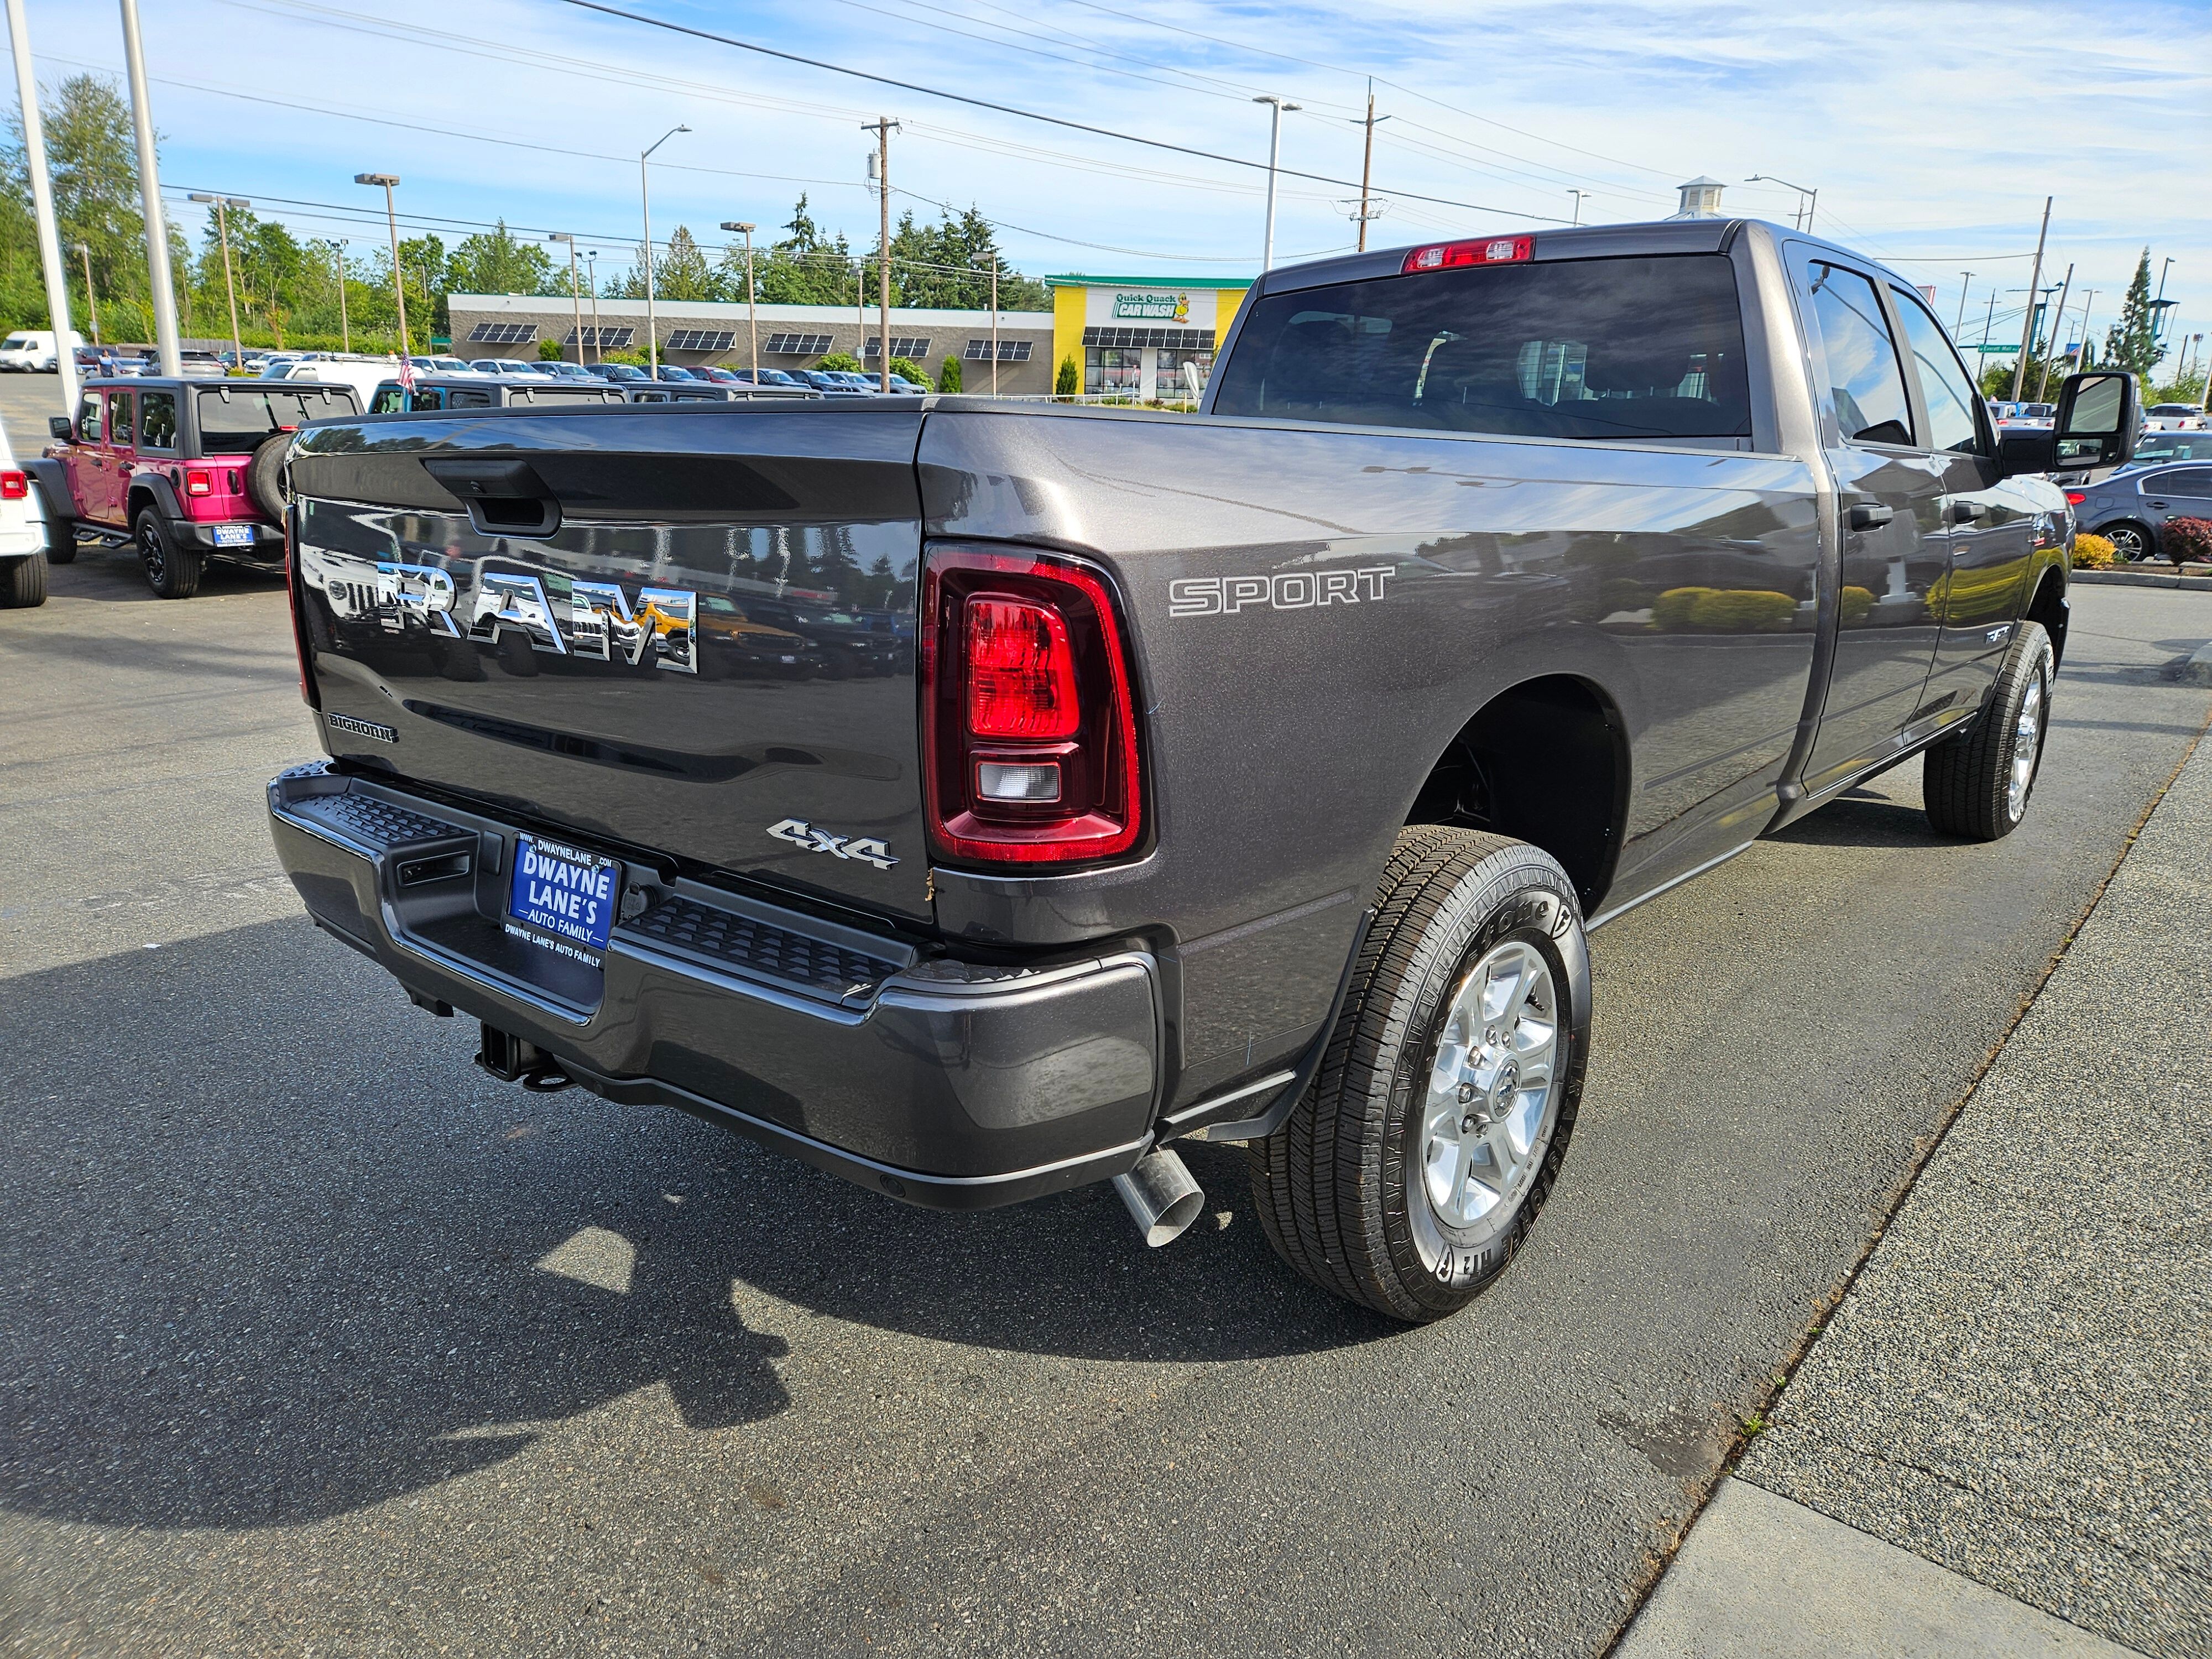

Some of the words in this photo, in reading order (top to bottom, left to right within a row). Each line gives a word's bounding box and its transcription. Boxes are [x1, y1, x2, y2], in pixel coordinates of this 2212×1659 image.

[1116, 294, 1144, 302] Quick
[1119, 303, 1142, 317] CAR
[1142, 304, 1176, 317] WASH
[1170, 566, 1395, 617] SPORT
[378, 562, 698, 674] RAM
[327, 712, 394, 743] BIGHORN
[538, 839, 592, 865] DWAYNELANE
[523, 851, 610, 900] DWAYNE
[529, 880, 598, 925] LANE'S
[505, 924, 531, 941] DWAYNE
[533, 933, 555, 950] LANE'S
[555, 943, 573, 957] AUTO
[573, 950, 601, 968] FAMILY
[528, 909, 555, 928] AUTO
[557, 919, 593, 942] FAMILY
[1500, 1056, 1587, 1262] TRANSFORCE
